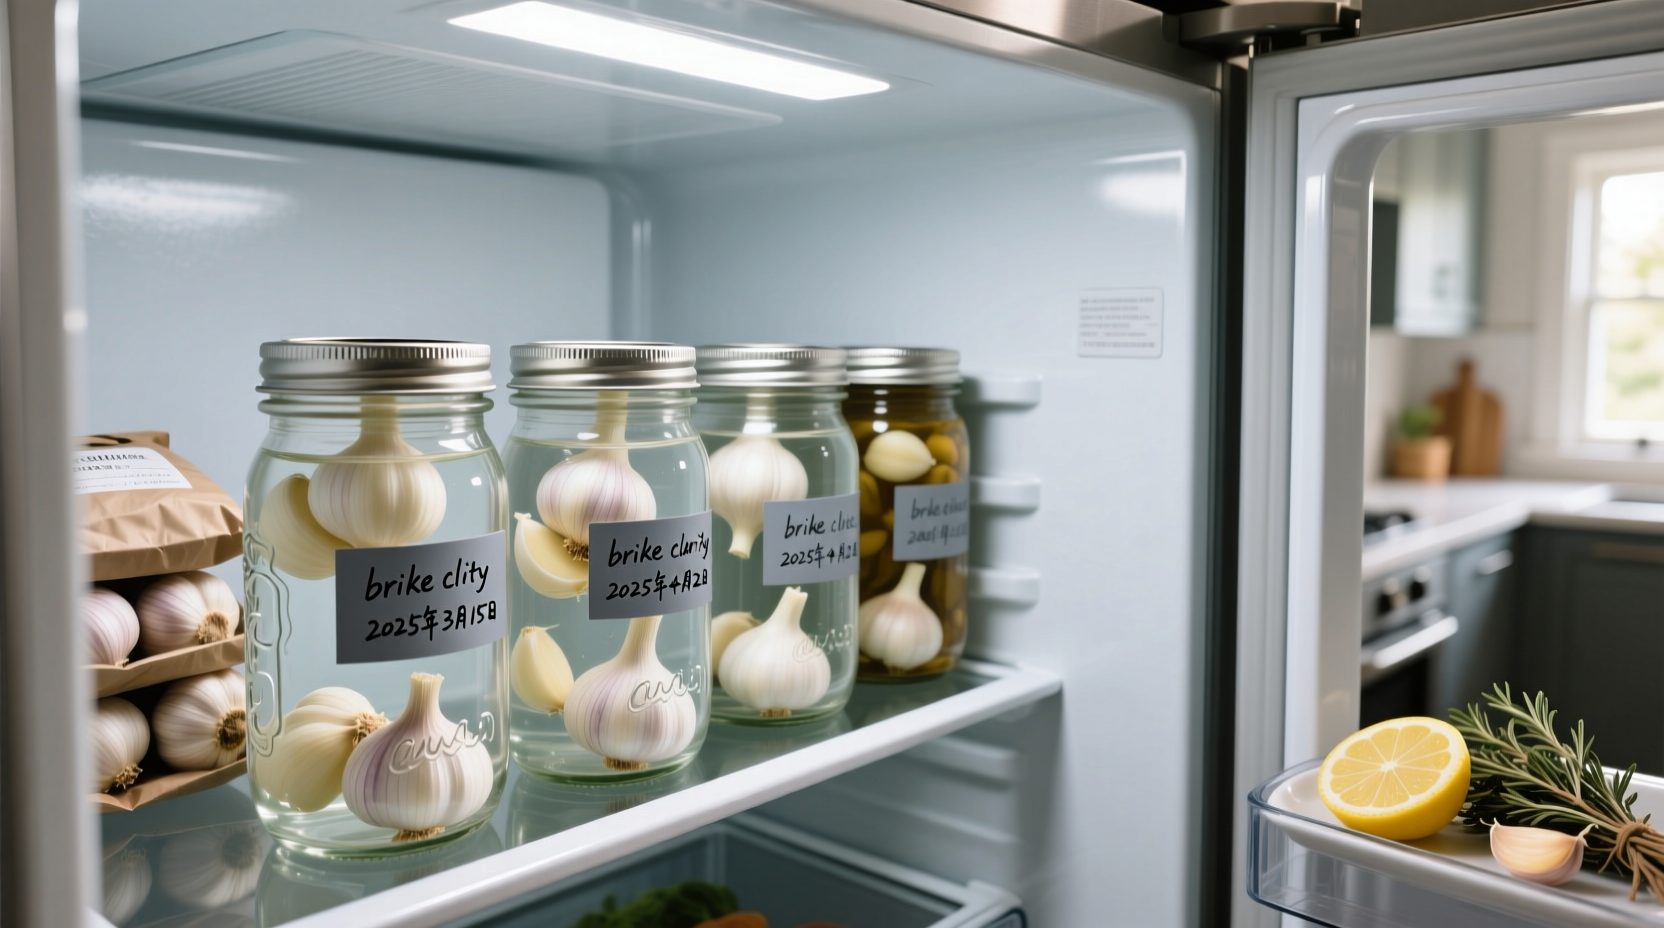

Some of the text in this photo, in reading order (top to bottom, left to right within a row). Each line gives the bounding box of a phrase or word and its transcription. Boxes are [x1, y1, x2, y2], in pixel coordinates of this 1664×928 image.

[784, 512, 826, 540] brike
[608, 536, 664, 568] brike
[364, 557, 489, 602] brike clity
[605, 568, 708, 602] 2025年4月2日
[365, 600, 497, 642] 2025年3月15日
